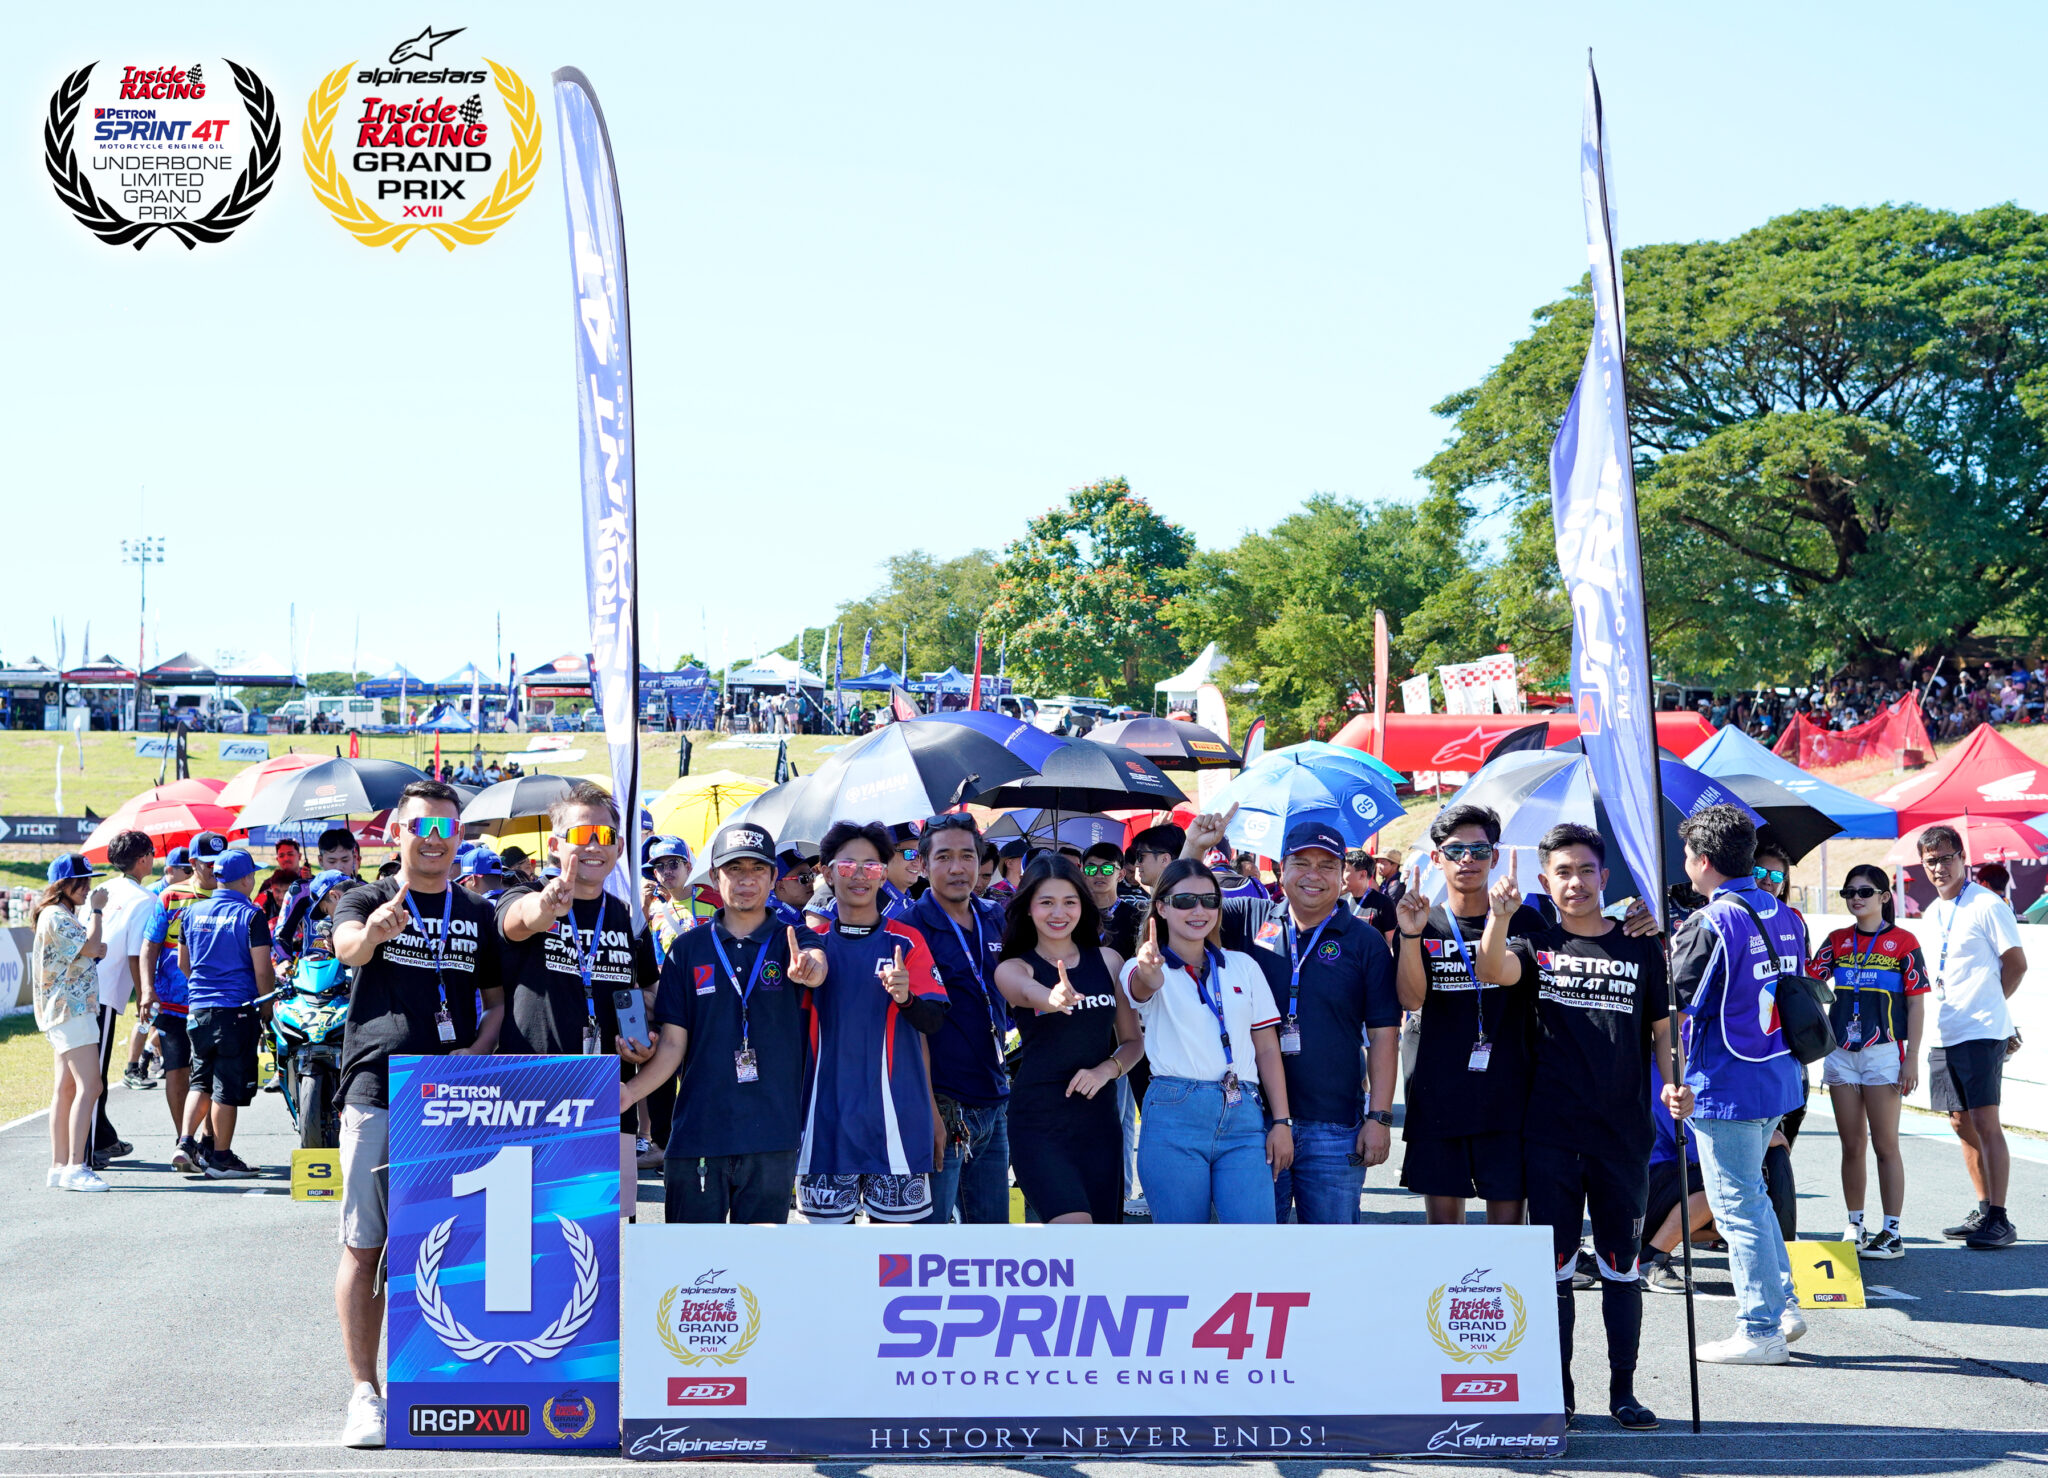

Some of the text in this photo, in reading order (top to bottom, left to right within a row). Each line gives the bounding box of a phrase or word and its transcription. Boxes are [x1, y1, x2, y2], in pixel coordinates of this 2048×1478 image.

[222, 745, 265, 757] Faito
[1356, 798, 1375, 814] GS
[15, 824, 57, 837] JTEKT
[840, 925, 871, 935] SEC
[451, 937, 478, 953] HTP
[608, 949, 632, 964] HTP
[1555, 954, 1639, 980] PETRON
[1538, 969, 1636, 995] SPRINT 4T HTP
[1589, 993, 1620, 1003] ENGINE
[1622, 997, 1635, 1006] OIL
[301, 1010, 336, 1031] 27
[437, 1083, 500, 1099] PETRON
[421, 1099, 594, 1127] SPRINT 4T
[307, 1163, 332, 1179] 3
[452, 1145, 533, 1312] 1
[919, 1253, 1075, 1288] PETRON
[1813, 1260, 1834, 1279] 1
[681, 1287, 737, 1296] alpinestars
[1448, 1285, 1502, 1294] alpinestars
[681, 1299, 724, 1312] Inside
[1449, 1298, 1491, 1310] Inside
[680, 1311, 737, 1322] RACING
[1449, 1309, 1505, 1320] RACING
[678, 1323, 739, 1333] GRAND
[877, 1292, 1311, 1361] SPRINT 4T
[1448, 1321, 1507, 1331] GRAND
[689, 1335, 727, 1345] PRIX
[1459, 1333, 1496, 1342] PRIX
[896, 1369, 1295, 1386] MOTORCYCLE ENGINE OIL
[678, 1383, 734, 1399] FDR
[1453, 1380, 1506, 1395] FDR
[413, 1409, 526, 1432] IRGPXVII
[870, 1425, 1328, 1449] HISTORY NEVER ENDS!
[1463, 1434, 1559, 1449] alpinestars
[667, 1438, 768, 1454] alpinestars
